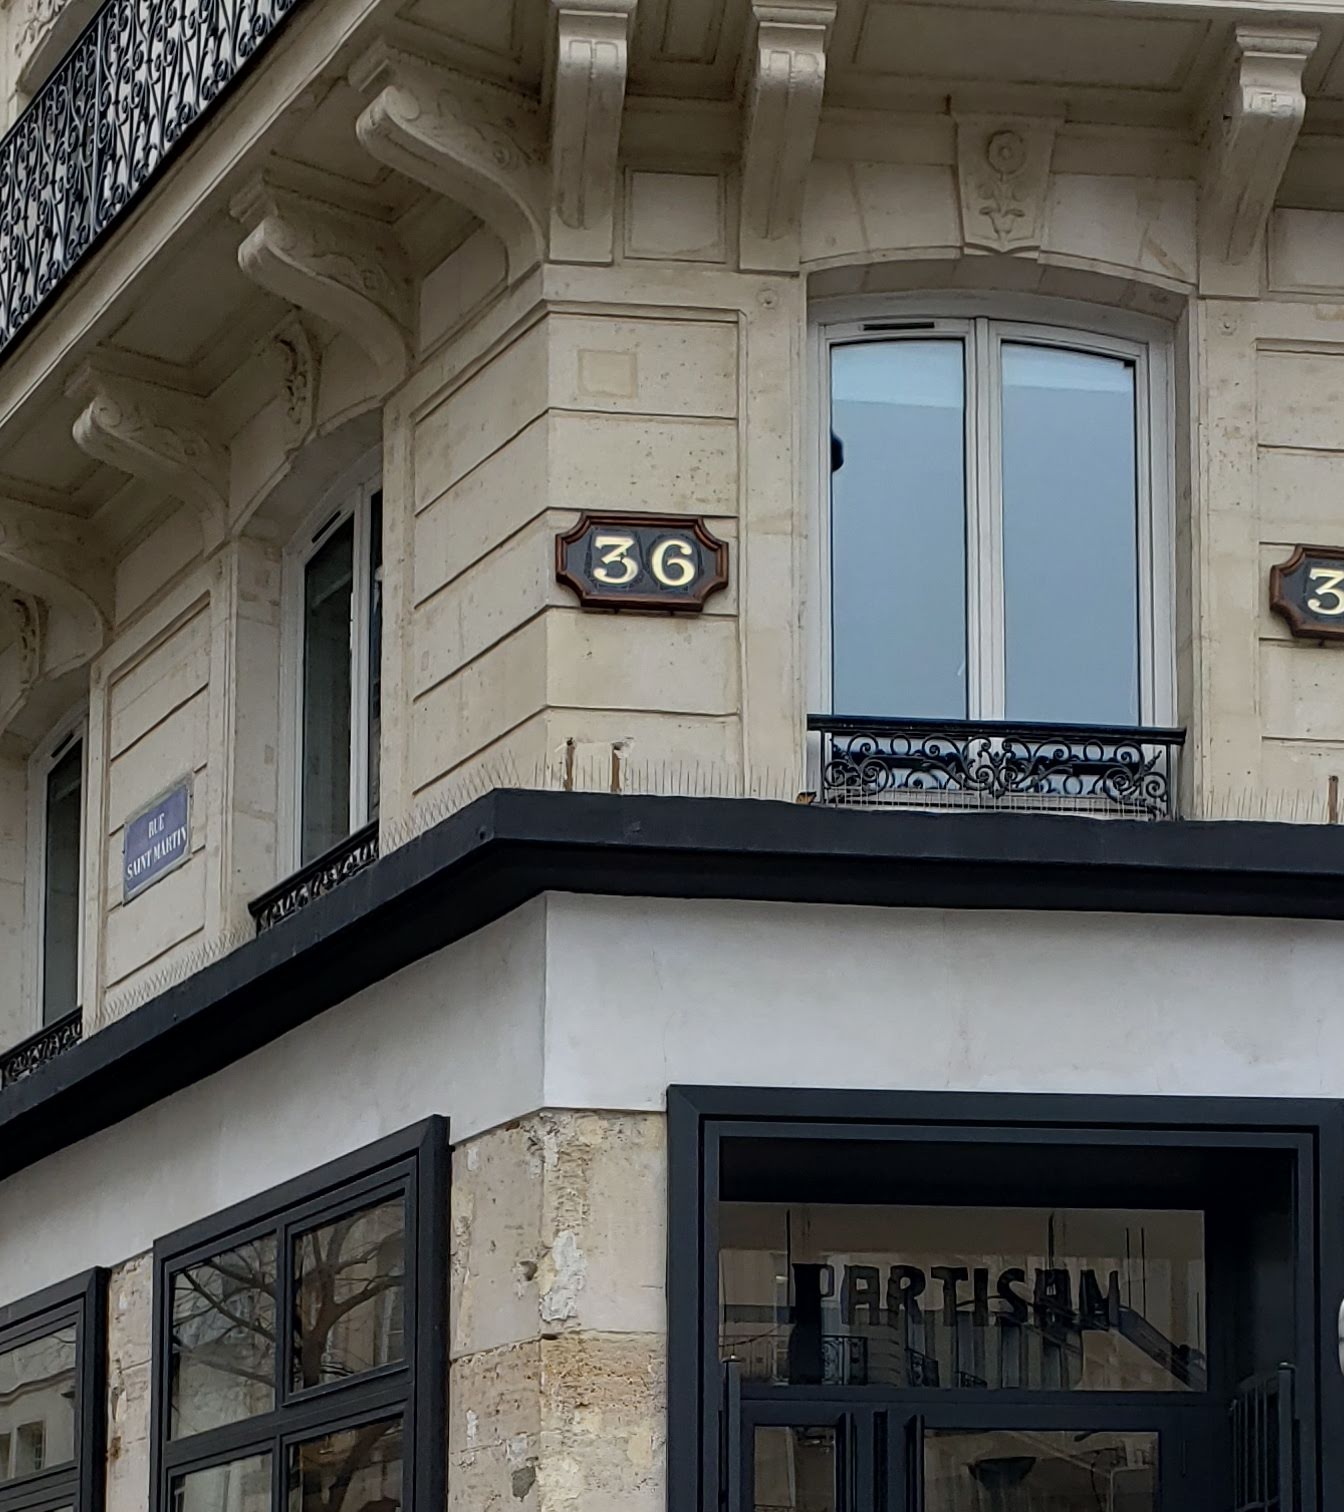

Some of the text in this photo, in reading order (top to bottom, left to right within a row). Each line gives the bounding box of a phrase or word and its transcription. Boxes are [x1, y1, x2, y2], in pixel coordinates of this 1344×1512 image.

[592, 535, 696, 587] 36
[148, 812, 165, 839] RUE
[127, 826, 187, 880] SAINT MARTIN
